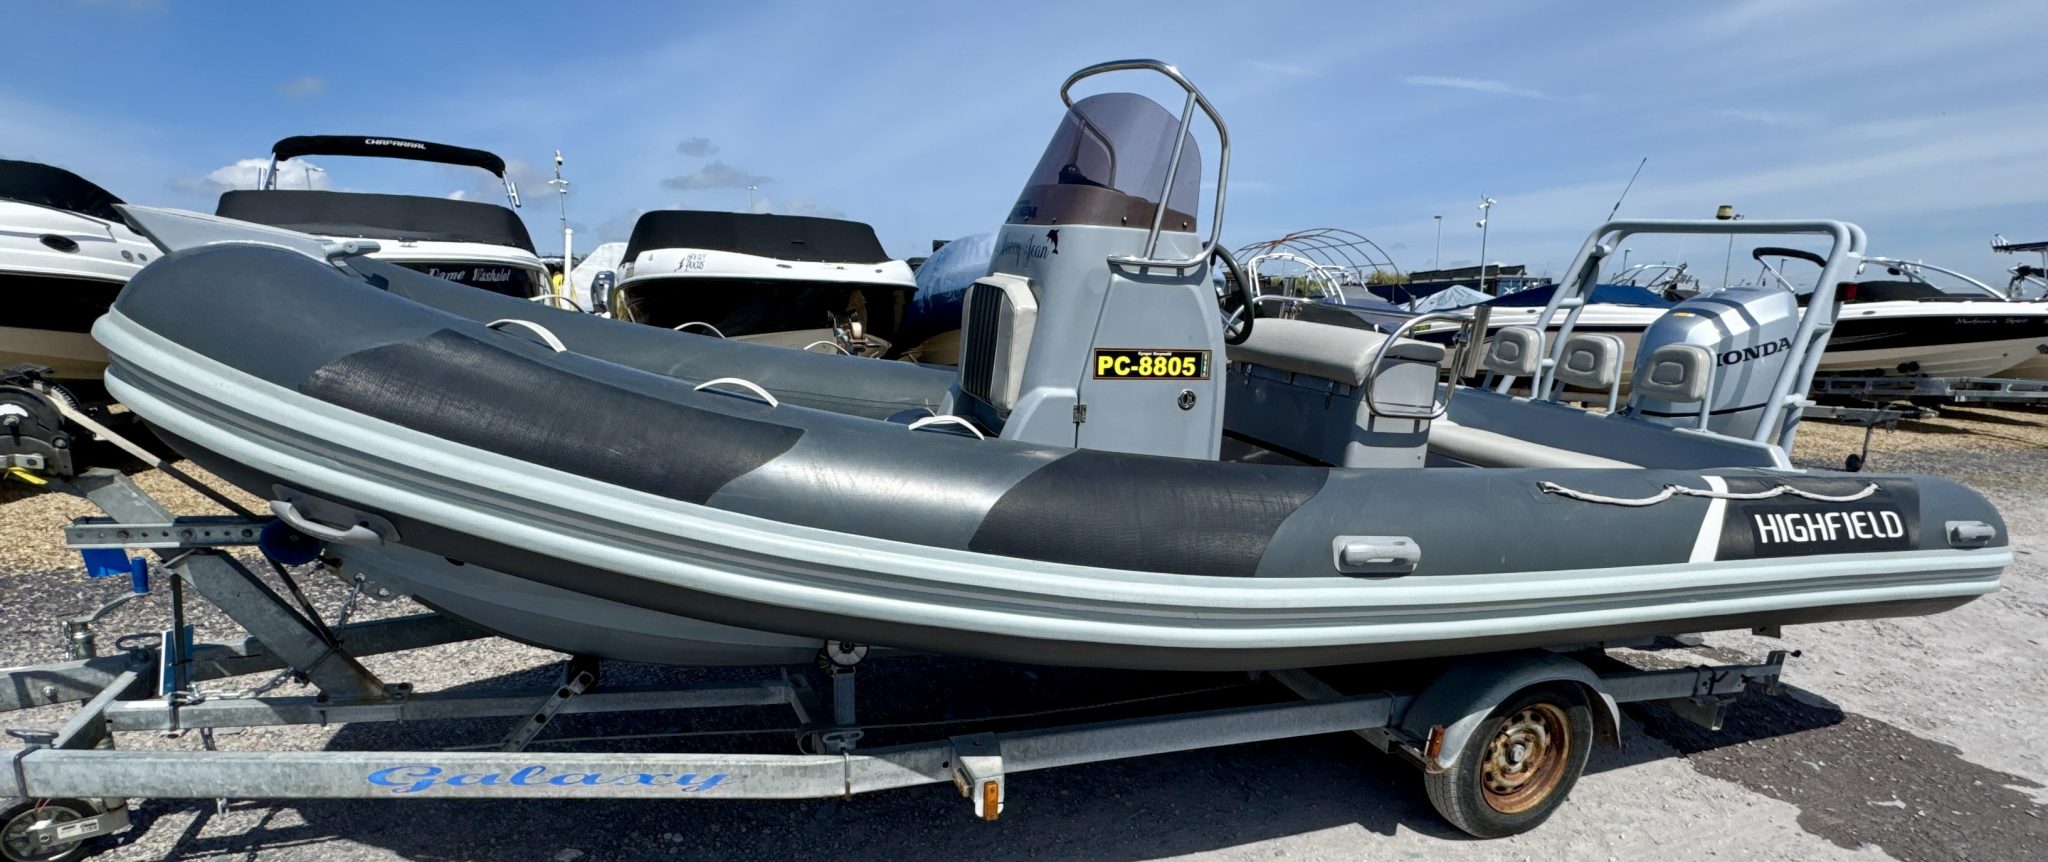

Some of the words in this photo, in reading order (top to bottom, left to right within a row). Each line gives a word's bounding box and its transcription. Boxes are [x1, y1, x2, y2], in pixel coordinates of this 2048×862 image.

[364, 138, 427, 150] CHAPARRAL
[429, 267, 466, 281] Dame
[1097, 355, 1196, 377] PC-8805
[1754, 510, 1904, 543] HIGHFIELD
[367, 764, 733, 794] Galaxy
